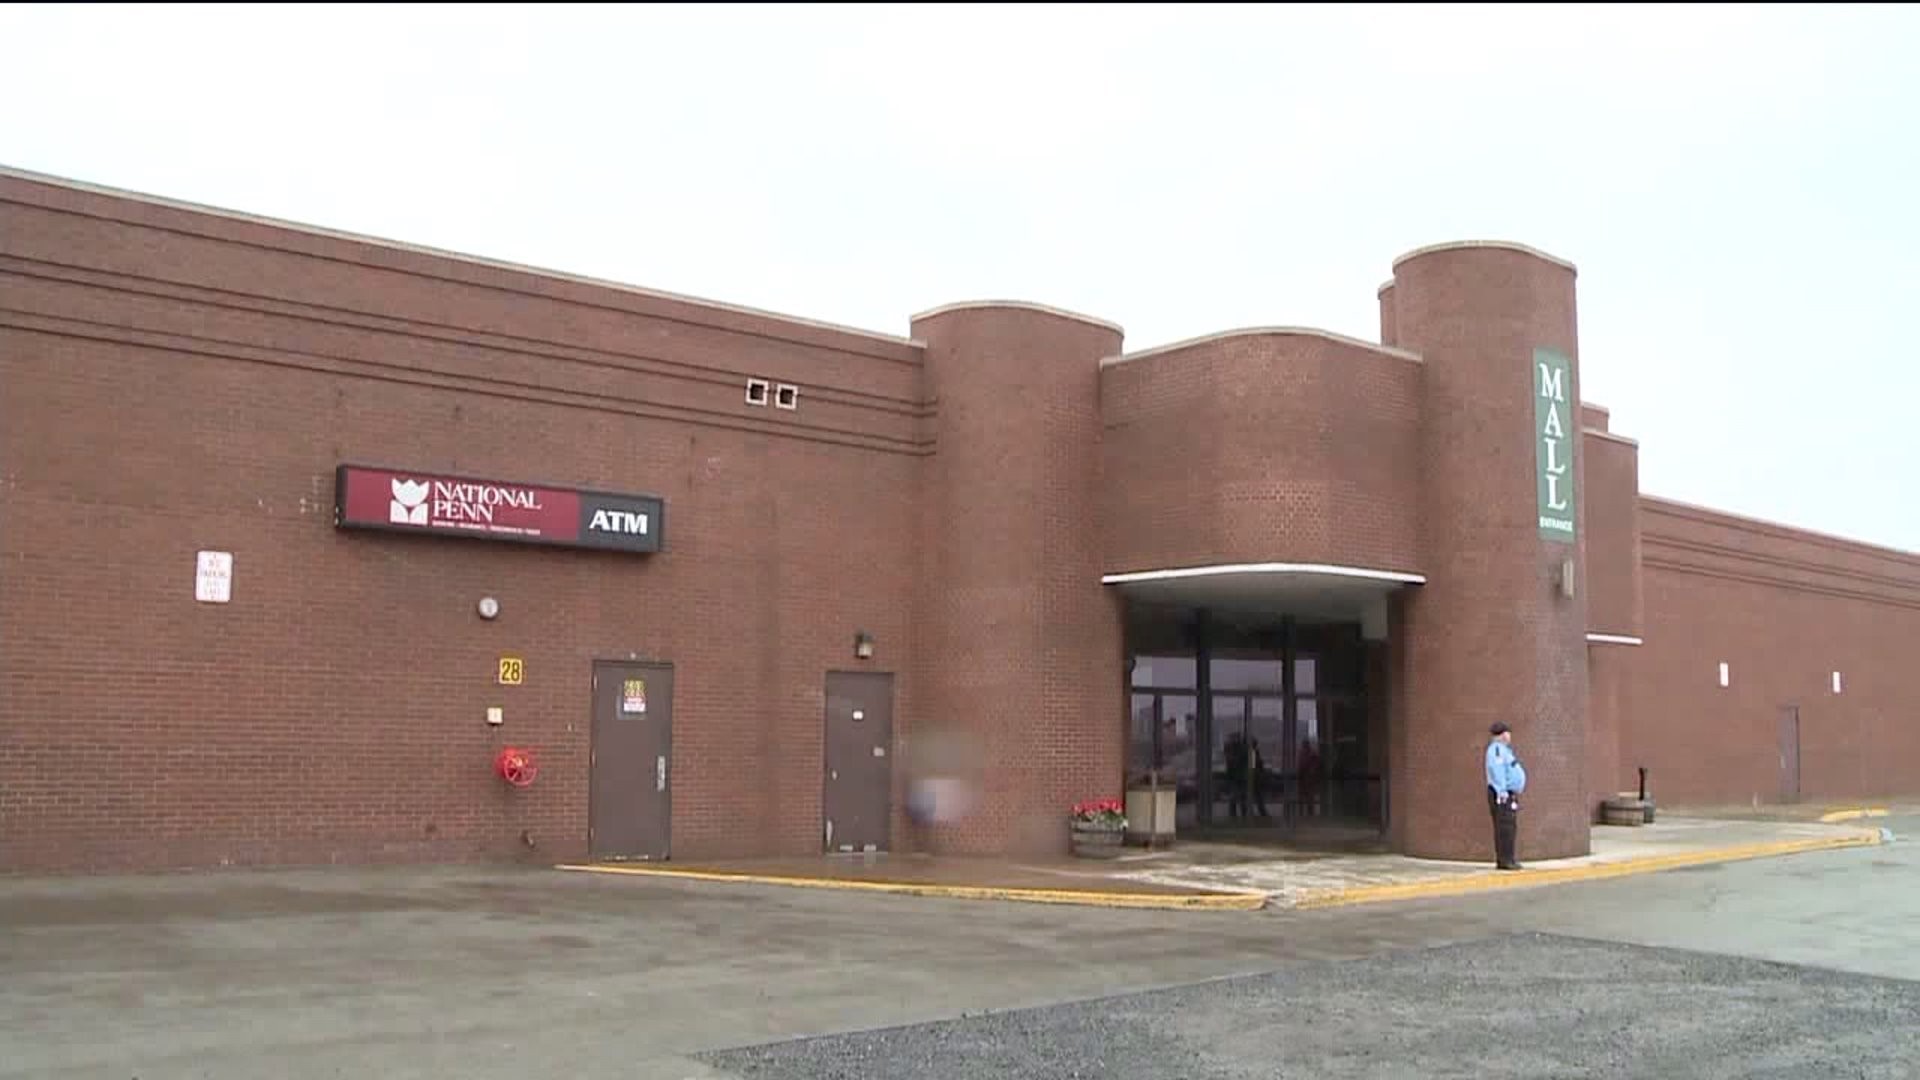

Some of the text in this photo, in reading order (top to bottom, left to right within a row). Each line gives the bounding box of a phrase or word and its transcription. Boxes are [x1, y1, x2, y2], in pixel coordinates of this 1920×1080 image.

[1539, 362, 1567, 511] MALL
[434, 481, 542, 509] NATIONAL
[434, 500, 493, 522] PENN
[589, 509, 649, 535] ATM
[502, 661, 520, 681] 28
